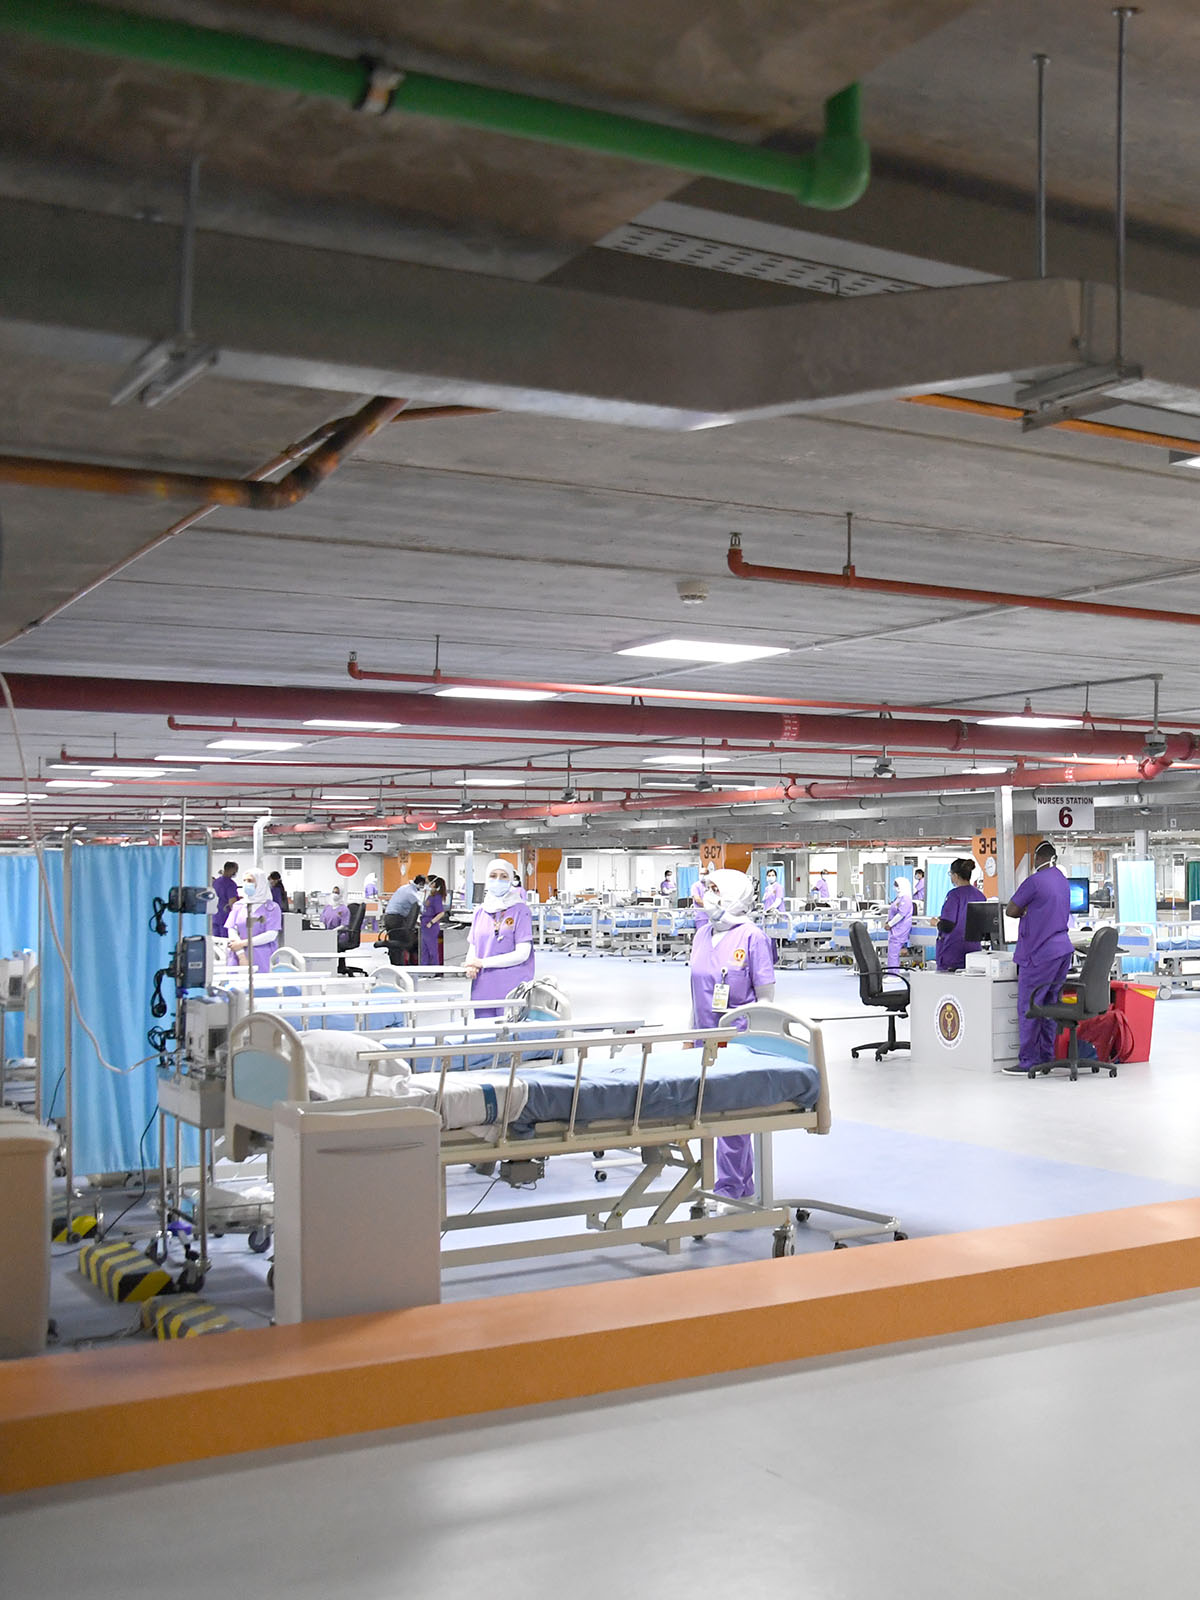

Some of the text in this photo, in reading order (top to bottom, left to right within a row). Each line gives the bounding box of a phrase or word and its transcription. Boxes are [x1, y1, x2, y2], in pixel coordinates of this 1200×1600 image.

[1059, 806, 1073, 828] 6
[364, 839, 373, 851] 5
[704, 846, 721, 859] 3-C7
